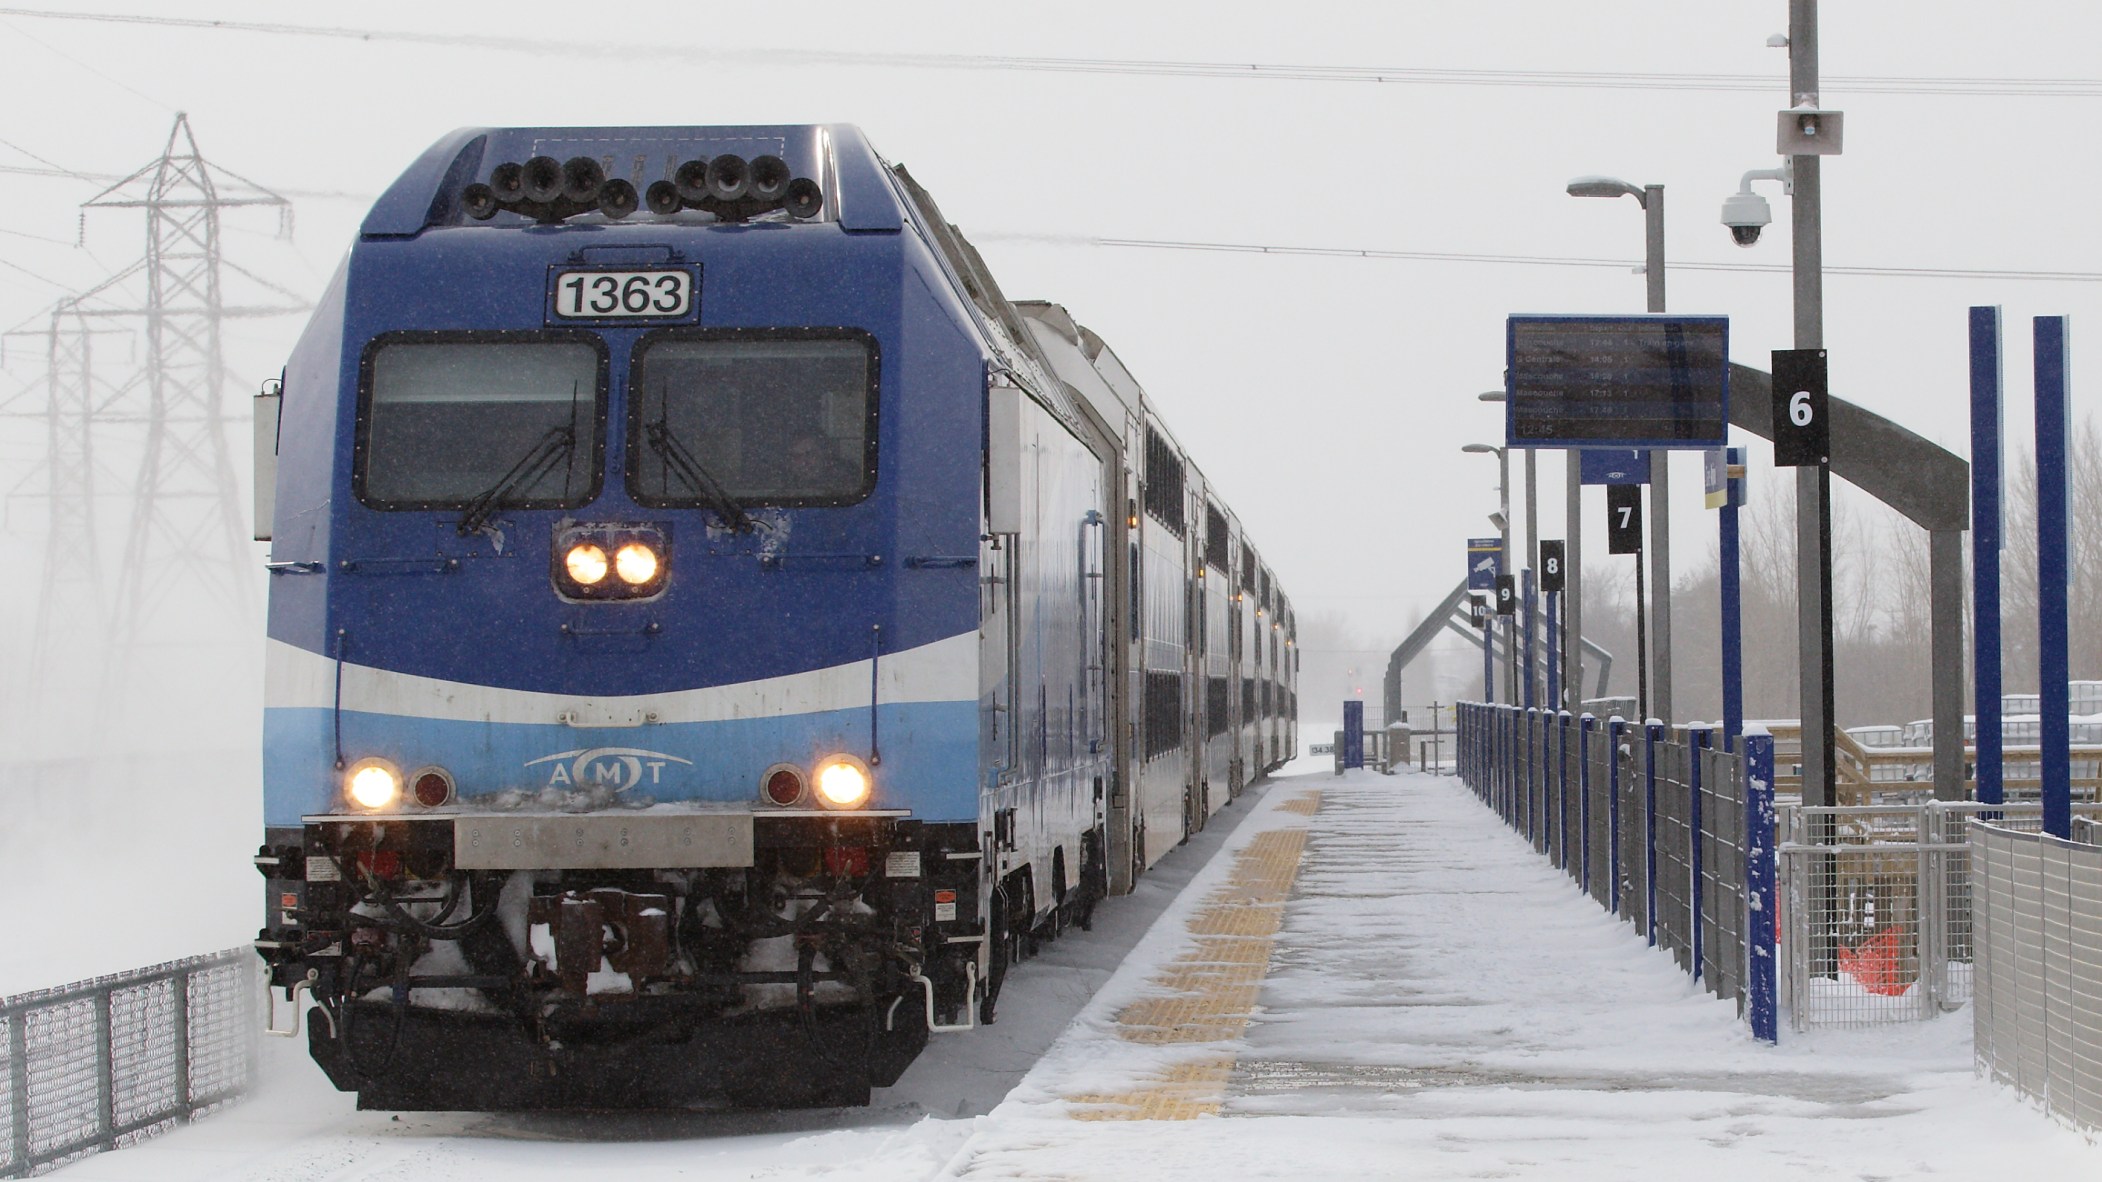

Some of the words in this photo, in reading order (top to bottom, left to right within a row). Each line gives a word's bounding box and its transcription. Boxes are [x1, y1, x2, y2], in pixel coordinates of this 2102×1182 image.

[566, 275, 682, 313] 1363
[1789, 391, 1813, 426] 6
[1617, 507, 1632, 528] 7
[1547, 557, 1558, 574] 8
[1501, 588, 1510, 601] 9
[1473, 605, 1486, 616] 10
[550, 762, 666, 785] AMT
